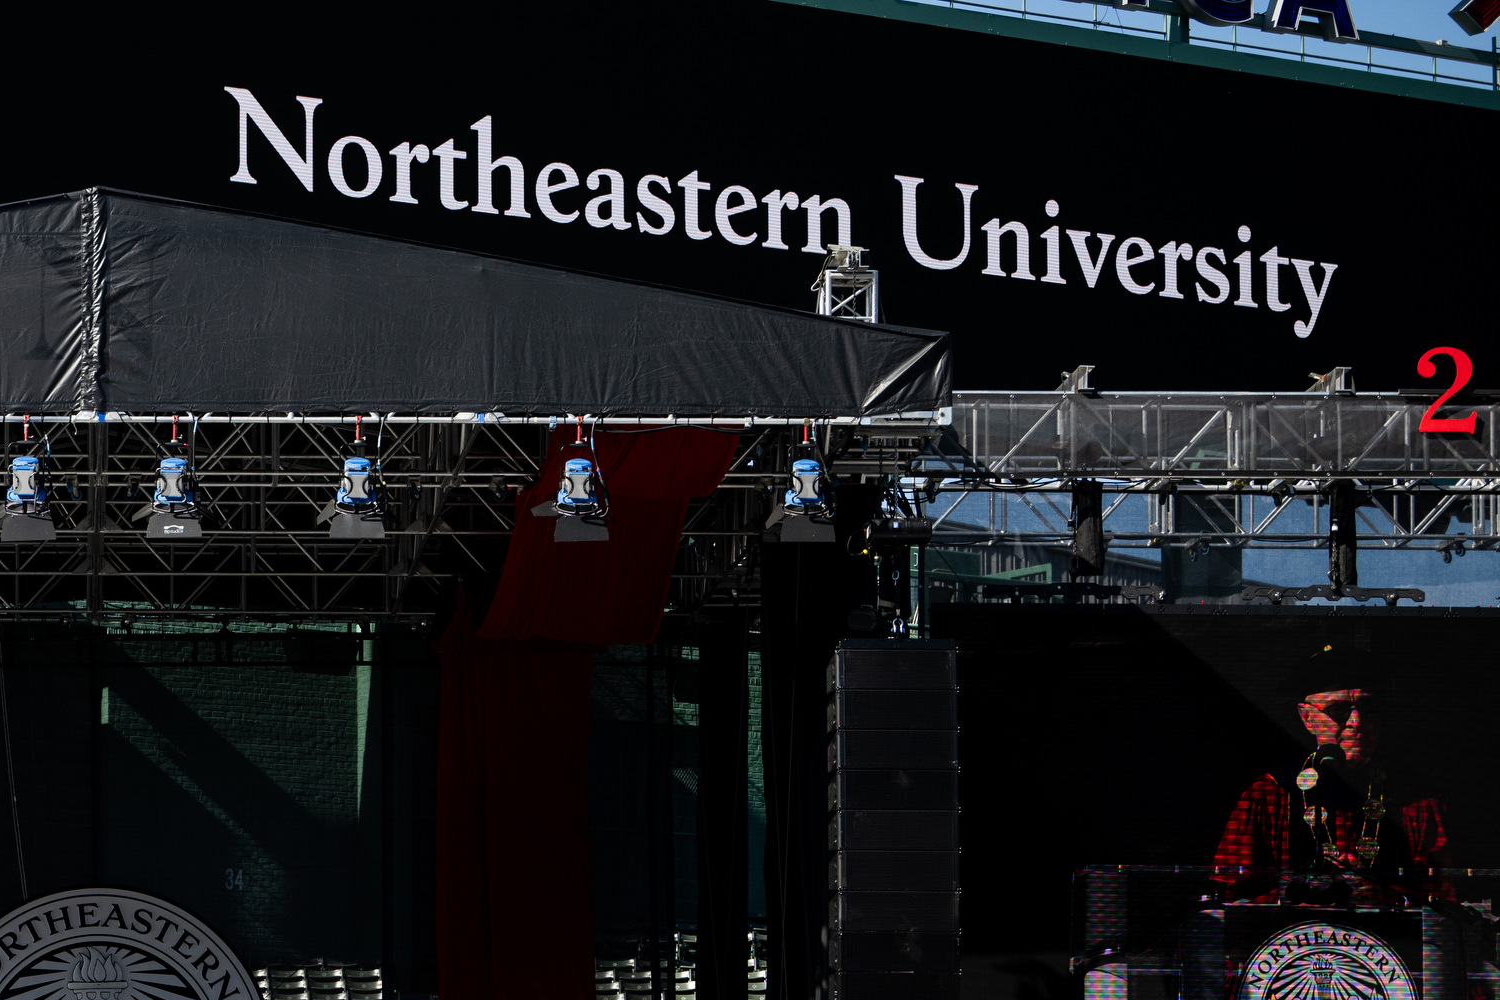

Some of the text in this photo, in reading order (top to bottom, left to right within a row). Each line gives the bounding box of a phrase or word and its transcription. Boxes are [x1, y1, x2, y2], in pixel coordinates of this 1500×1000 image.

[224, 86, 1339, 339] Northeastern University
[1417, 346, 1478, 434] 2
[224, 868, 244, 890] 34
[1247, 930, 1401, 991] NORTHEASTERN
